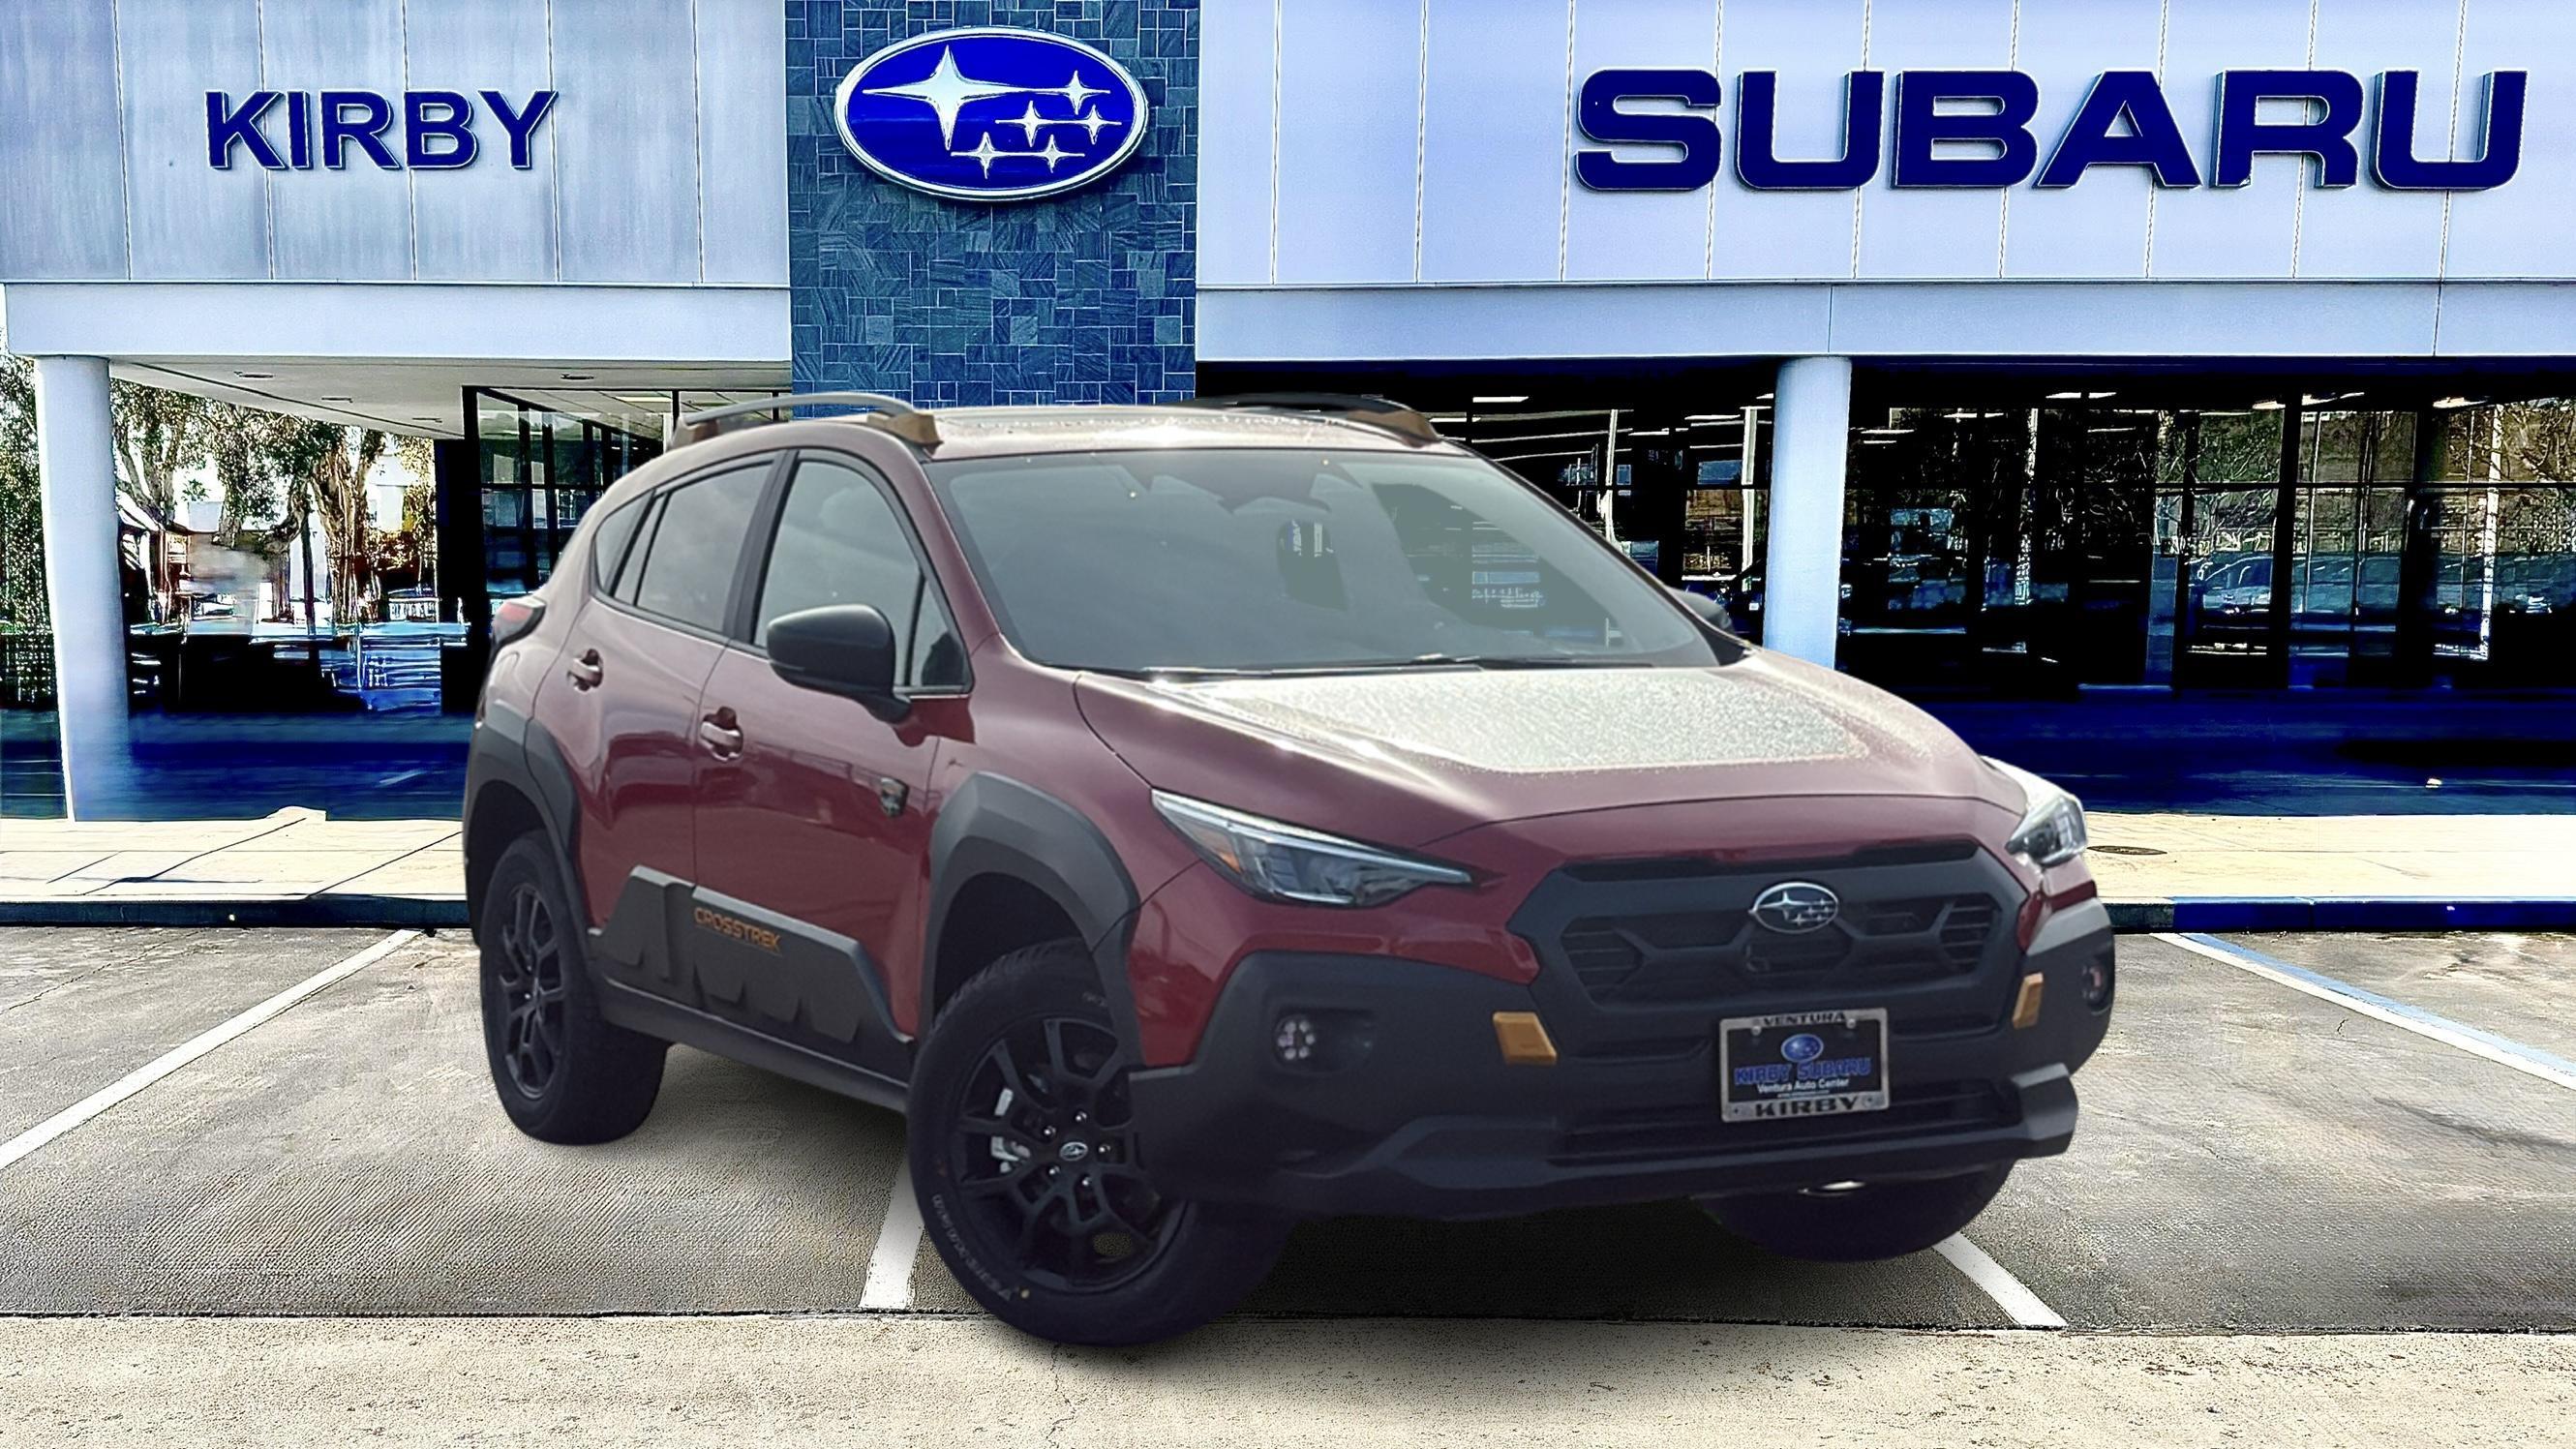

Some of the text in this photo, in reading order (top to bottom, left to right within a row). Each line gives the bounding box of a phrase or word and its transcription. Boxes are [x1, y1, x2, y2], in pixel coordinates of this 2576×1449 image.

[206, 91, 557, 169] KIRBY
[1576, 70, 2527, 192] SUBARU
[694, 907, 780, 952] CROSSTREK
[1763, 1012, 1846, 1027] VENTURA
[1734, 1057, 1872, 1086] KIRBY SUBARU
[1757, 1083, 1793, 1094] Ventura
[1795, 1080, 1816, 1090] Auto
[1818, 1077, 1850, 1089] Center
[1755, 1096, 1859, 1118] KIRBY
